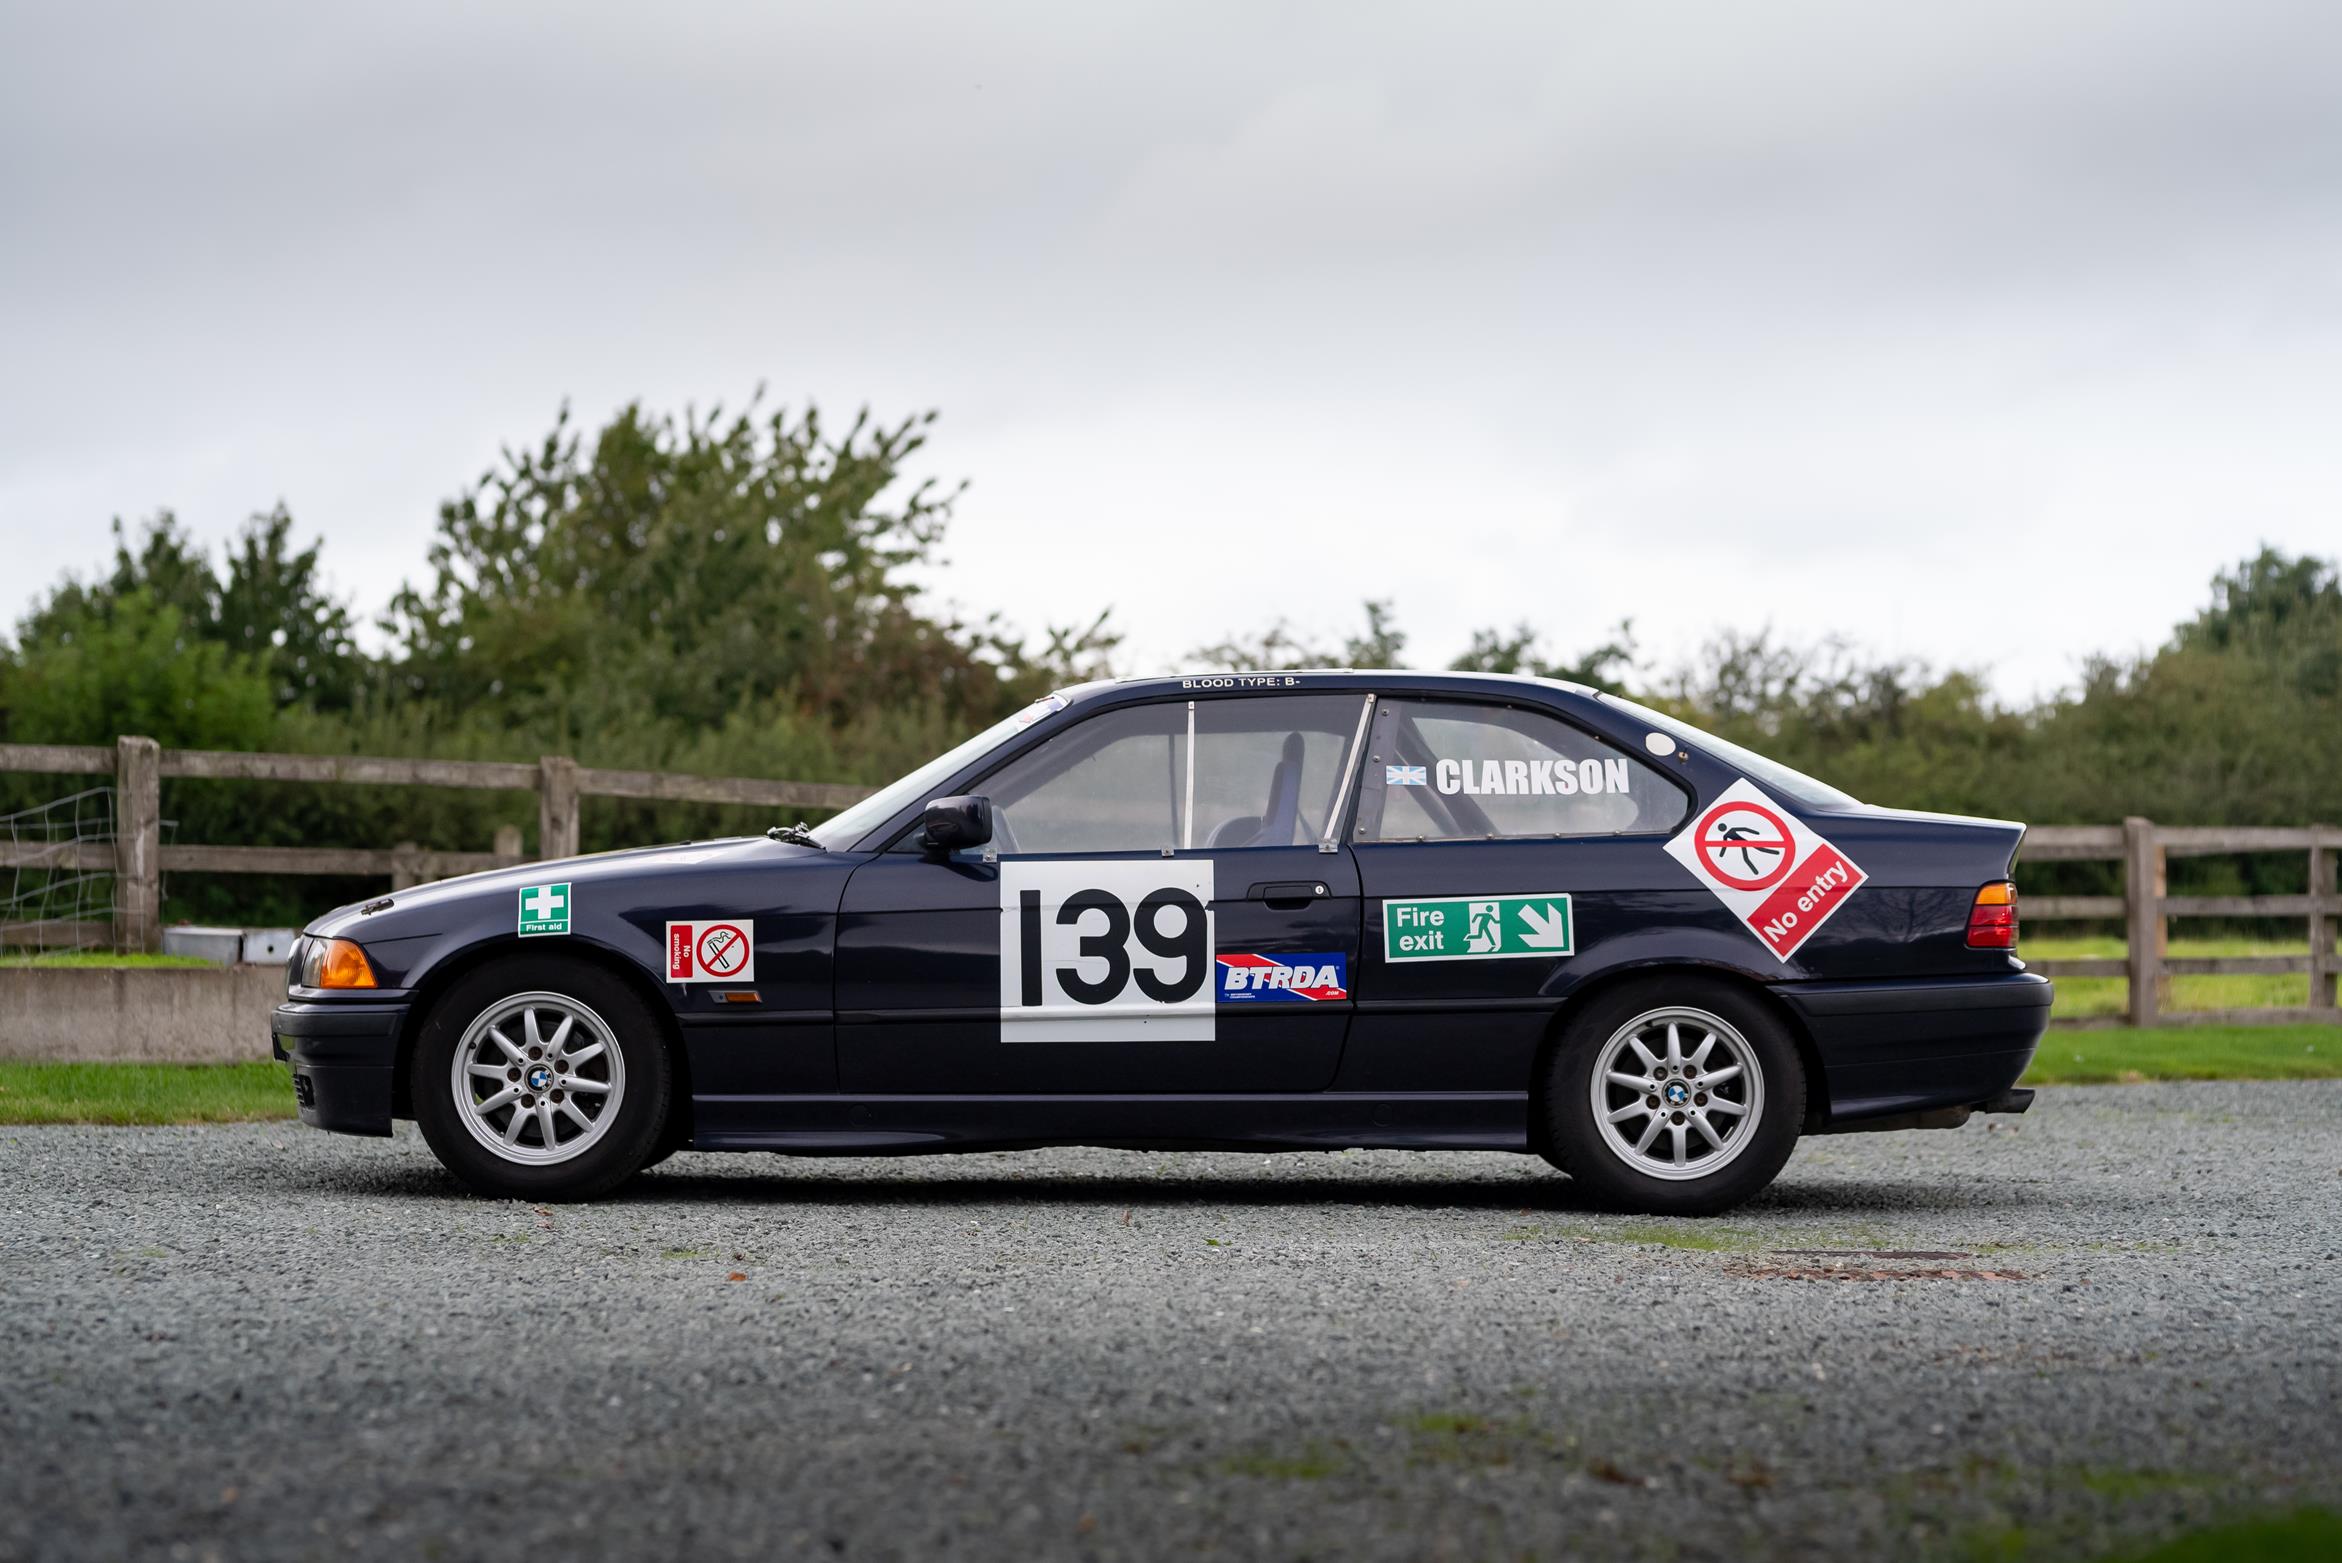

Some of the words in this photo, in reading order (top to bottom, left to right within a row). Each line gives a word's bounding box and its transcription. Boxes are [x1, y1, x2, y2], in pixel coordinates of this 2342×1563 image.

[1182, 678, 1234, 689] BLOOD
[1238, 677, 1280, 688] TYPE:
[1284, 676, 1301, 686] B-
[1435, 758, 1630, 796] CLARKSON
[1763, 910, 1798, 944] No
[1797, 859, 1850, 914] entry
[526, 923, 546, 932] First
[548, 922, 562, 931] aid
[1396, 907, 1445, 928] Fire
[672, 933, 680, 970] smoking
[683, 944, 690, 958] No
[1019, 887, 1208, 1007] 139
[1399, 928, 1444, 952] exit
[1224, 965, 1340, 991] BTRDA
